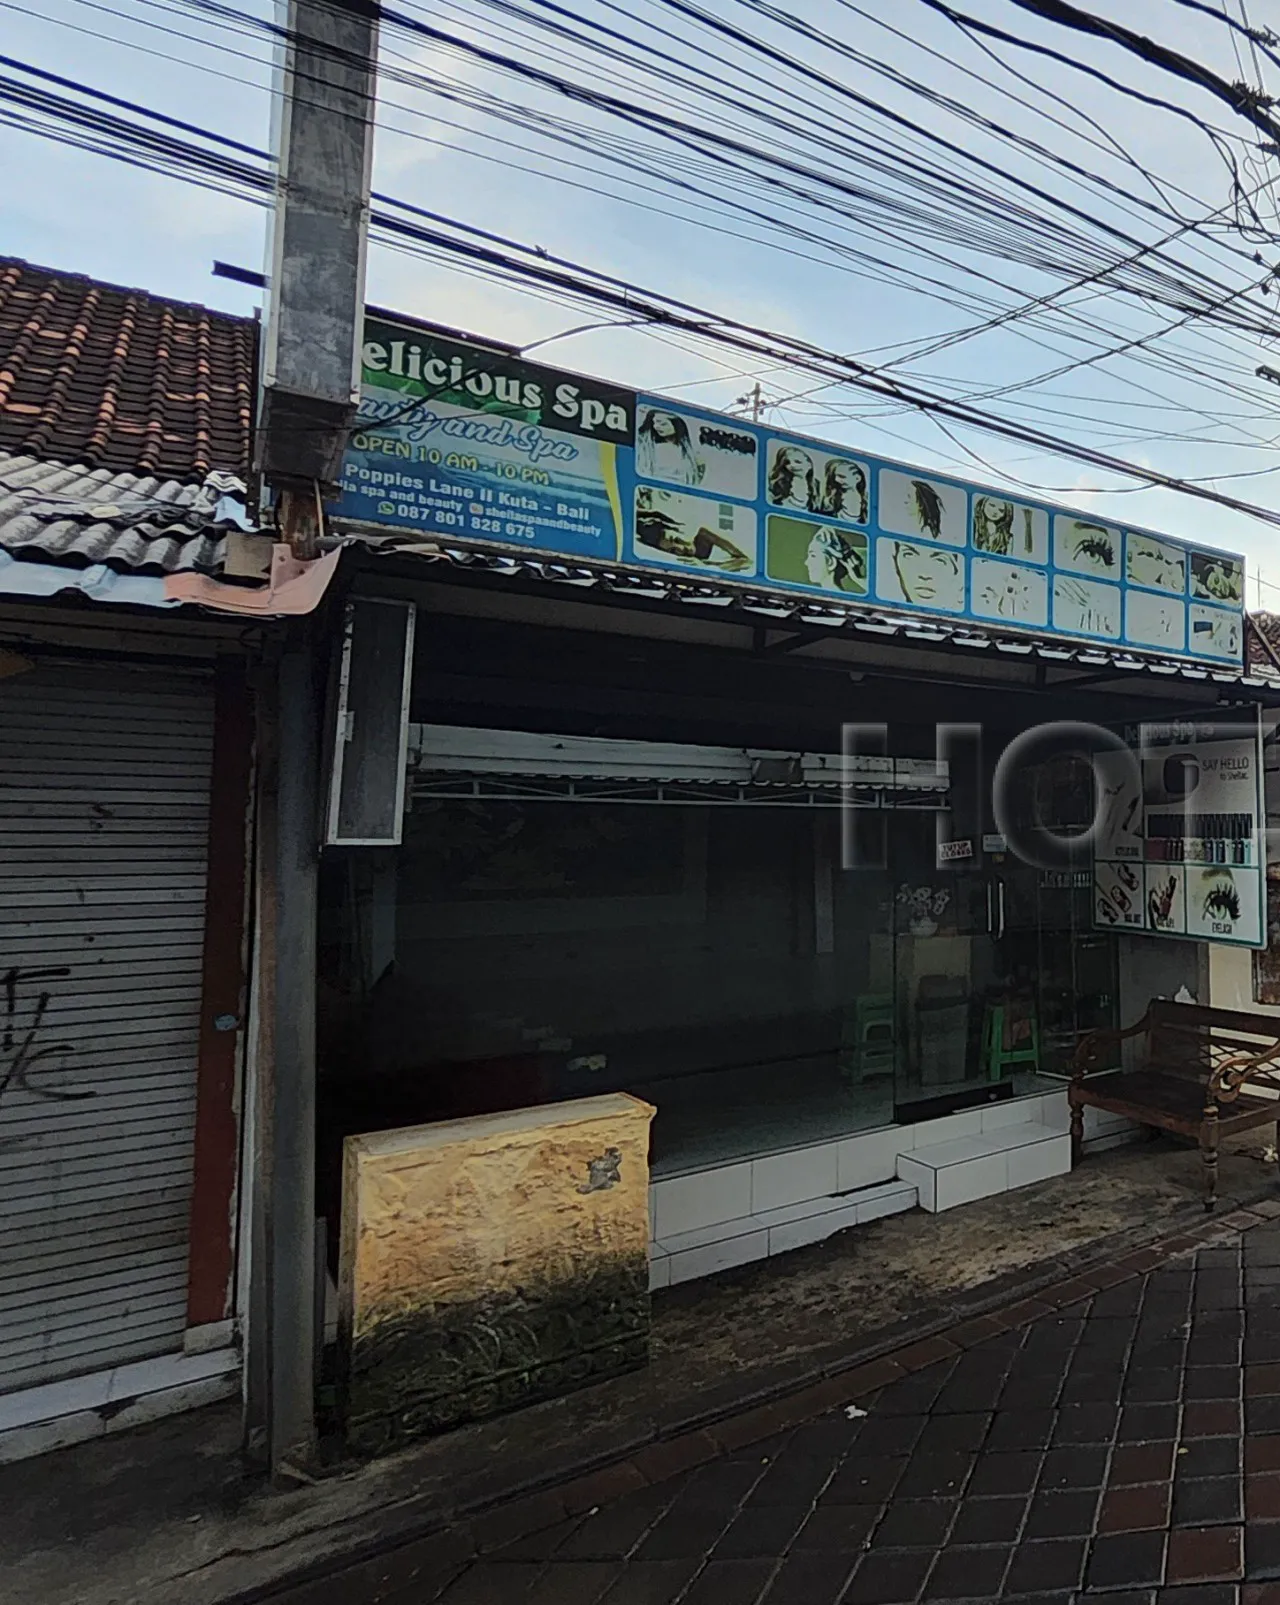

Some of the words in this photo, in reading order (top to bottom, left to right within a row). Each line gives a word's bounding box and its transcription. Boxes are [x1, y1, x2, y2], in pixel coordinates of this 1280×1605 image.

[361, 341, 542, 409] elicious
[552, 384, 628, 431] Spa
[357, 397, 440, 441] auty
[442, 417, 514, 446] and
[512, 424, 579, 462] Spa
[352, 433, 411, 459] OPEN
[418, 445, 442, 464] 10
[445, 452, 478, 472] AM
[495, 462, 516, 479] 10
[520, 465, 550, 486] PM
[345, 463, 424, 489] Poppies
[429, 479, 474, 498] Lane
[498, 492, 539, 511] Kuta
[557, 503, 589, 520] Bali
[360, 485, 387, 497] spa
[389, 490, 415, 503] and
[418, 494, 463, 513] beauty
[397, 504, 430, 520] 087
[435, 511, 464, 527] 801
[471, 517, 501, 533] 828
[505, 522, 536, 539] 675
[1202, 760, 1218, 771] SAY
[1220, 757, 1249, 770] HELLO
